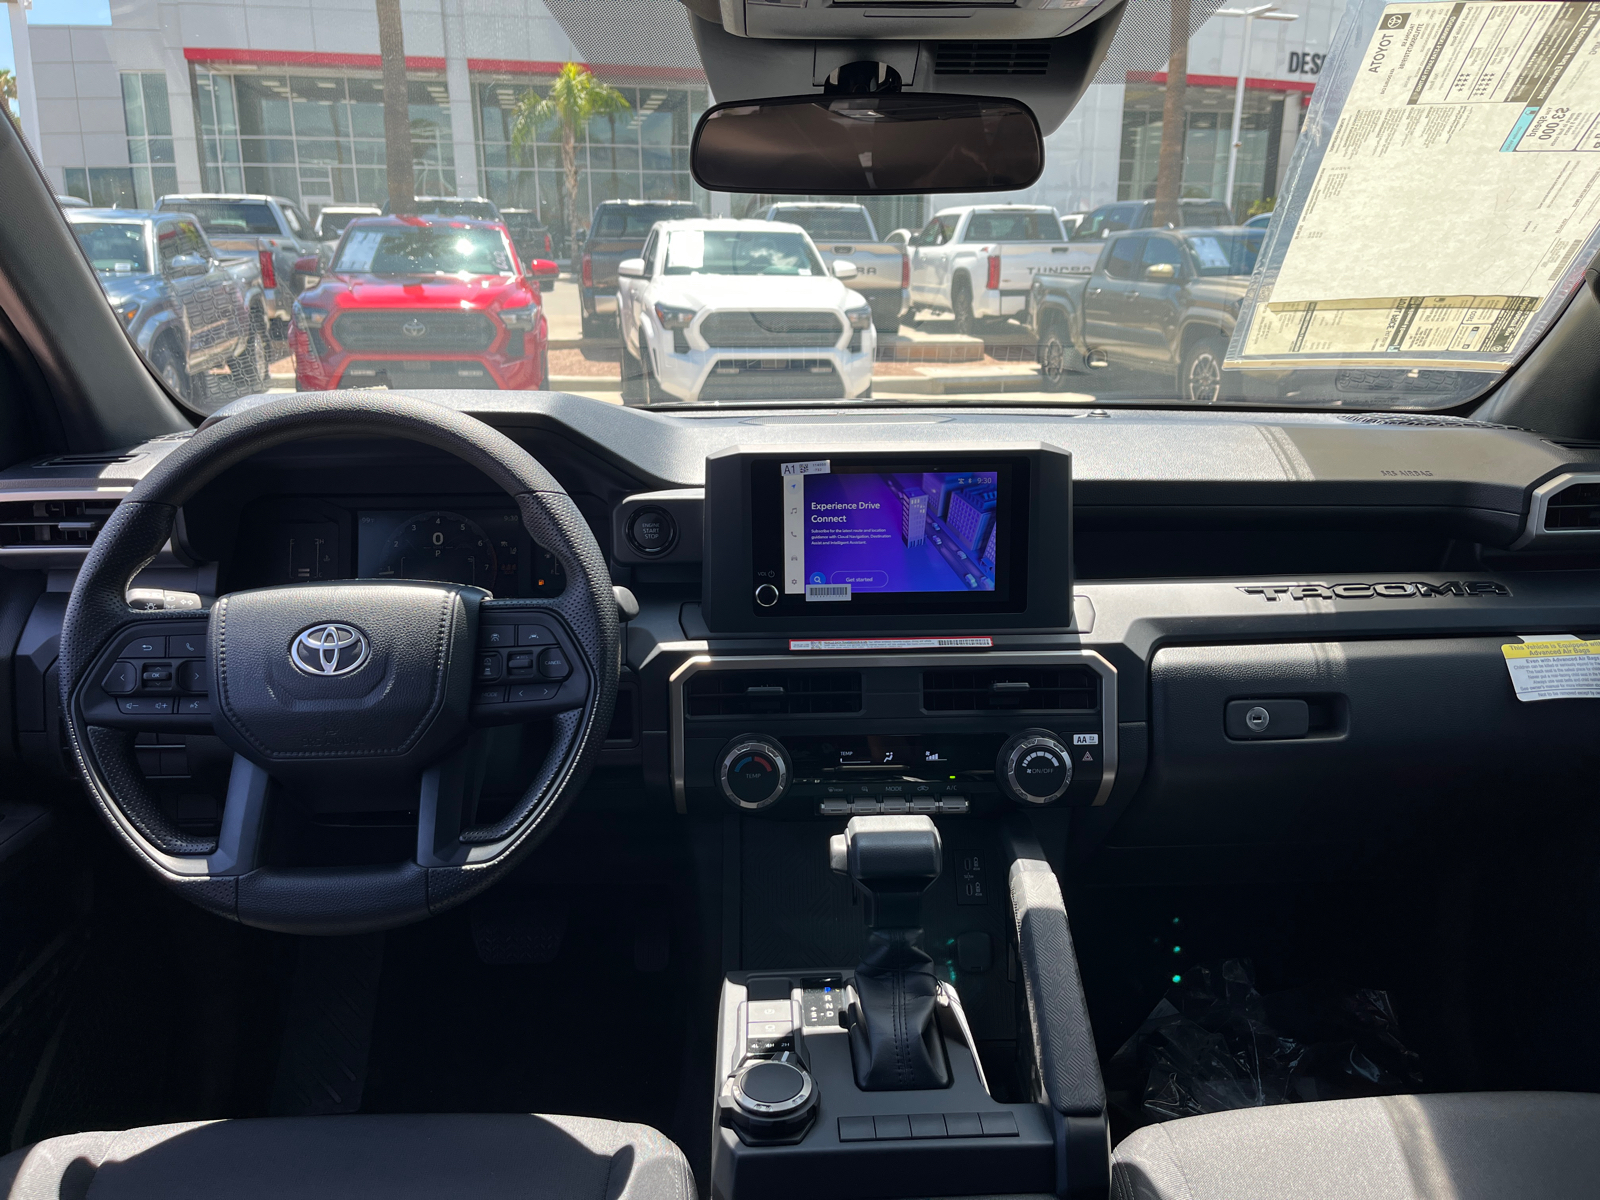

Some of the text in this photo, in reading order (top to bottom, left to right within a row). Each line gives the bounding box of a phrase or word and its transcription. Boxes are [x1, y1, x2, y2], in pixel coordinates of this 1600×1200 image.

[784, 464, 796, 474] A1
[811, 502, 857, 511] Experience
[432, 532, 444, 545] 0
[1236, 580, 1512, 602] TACOMA
